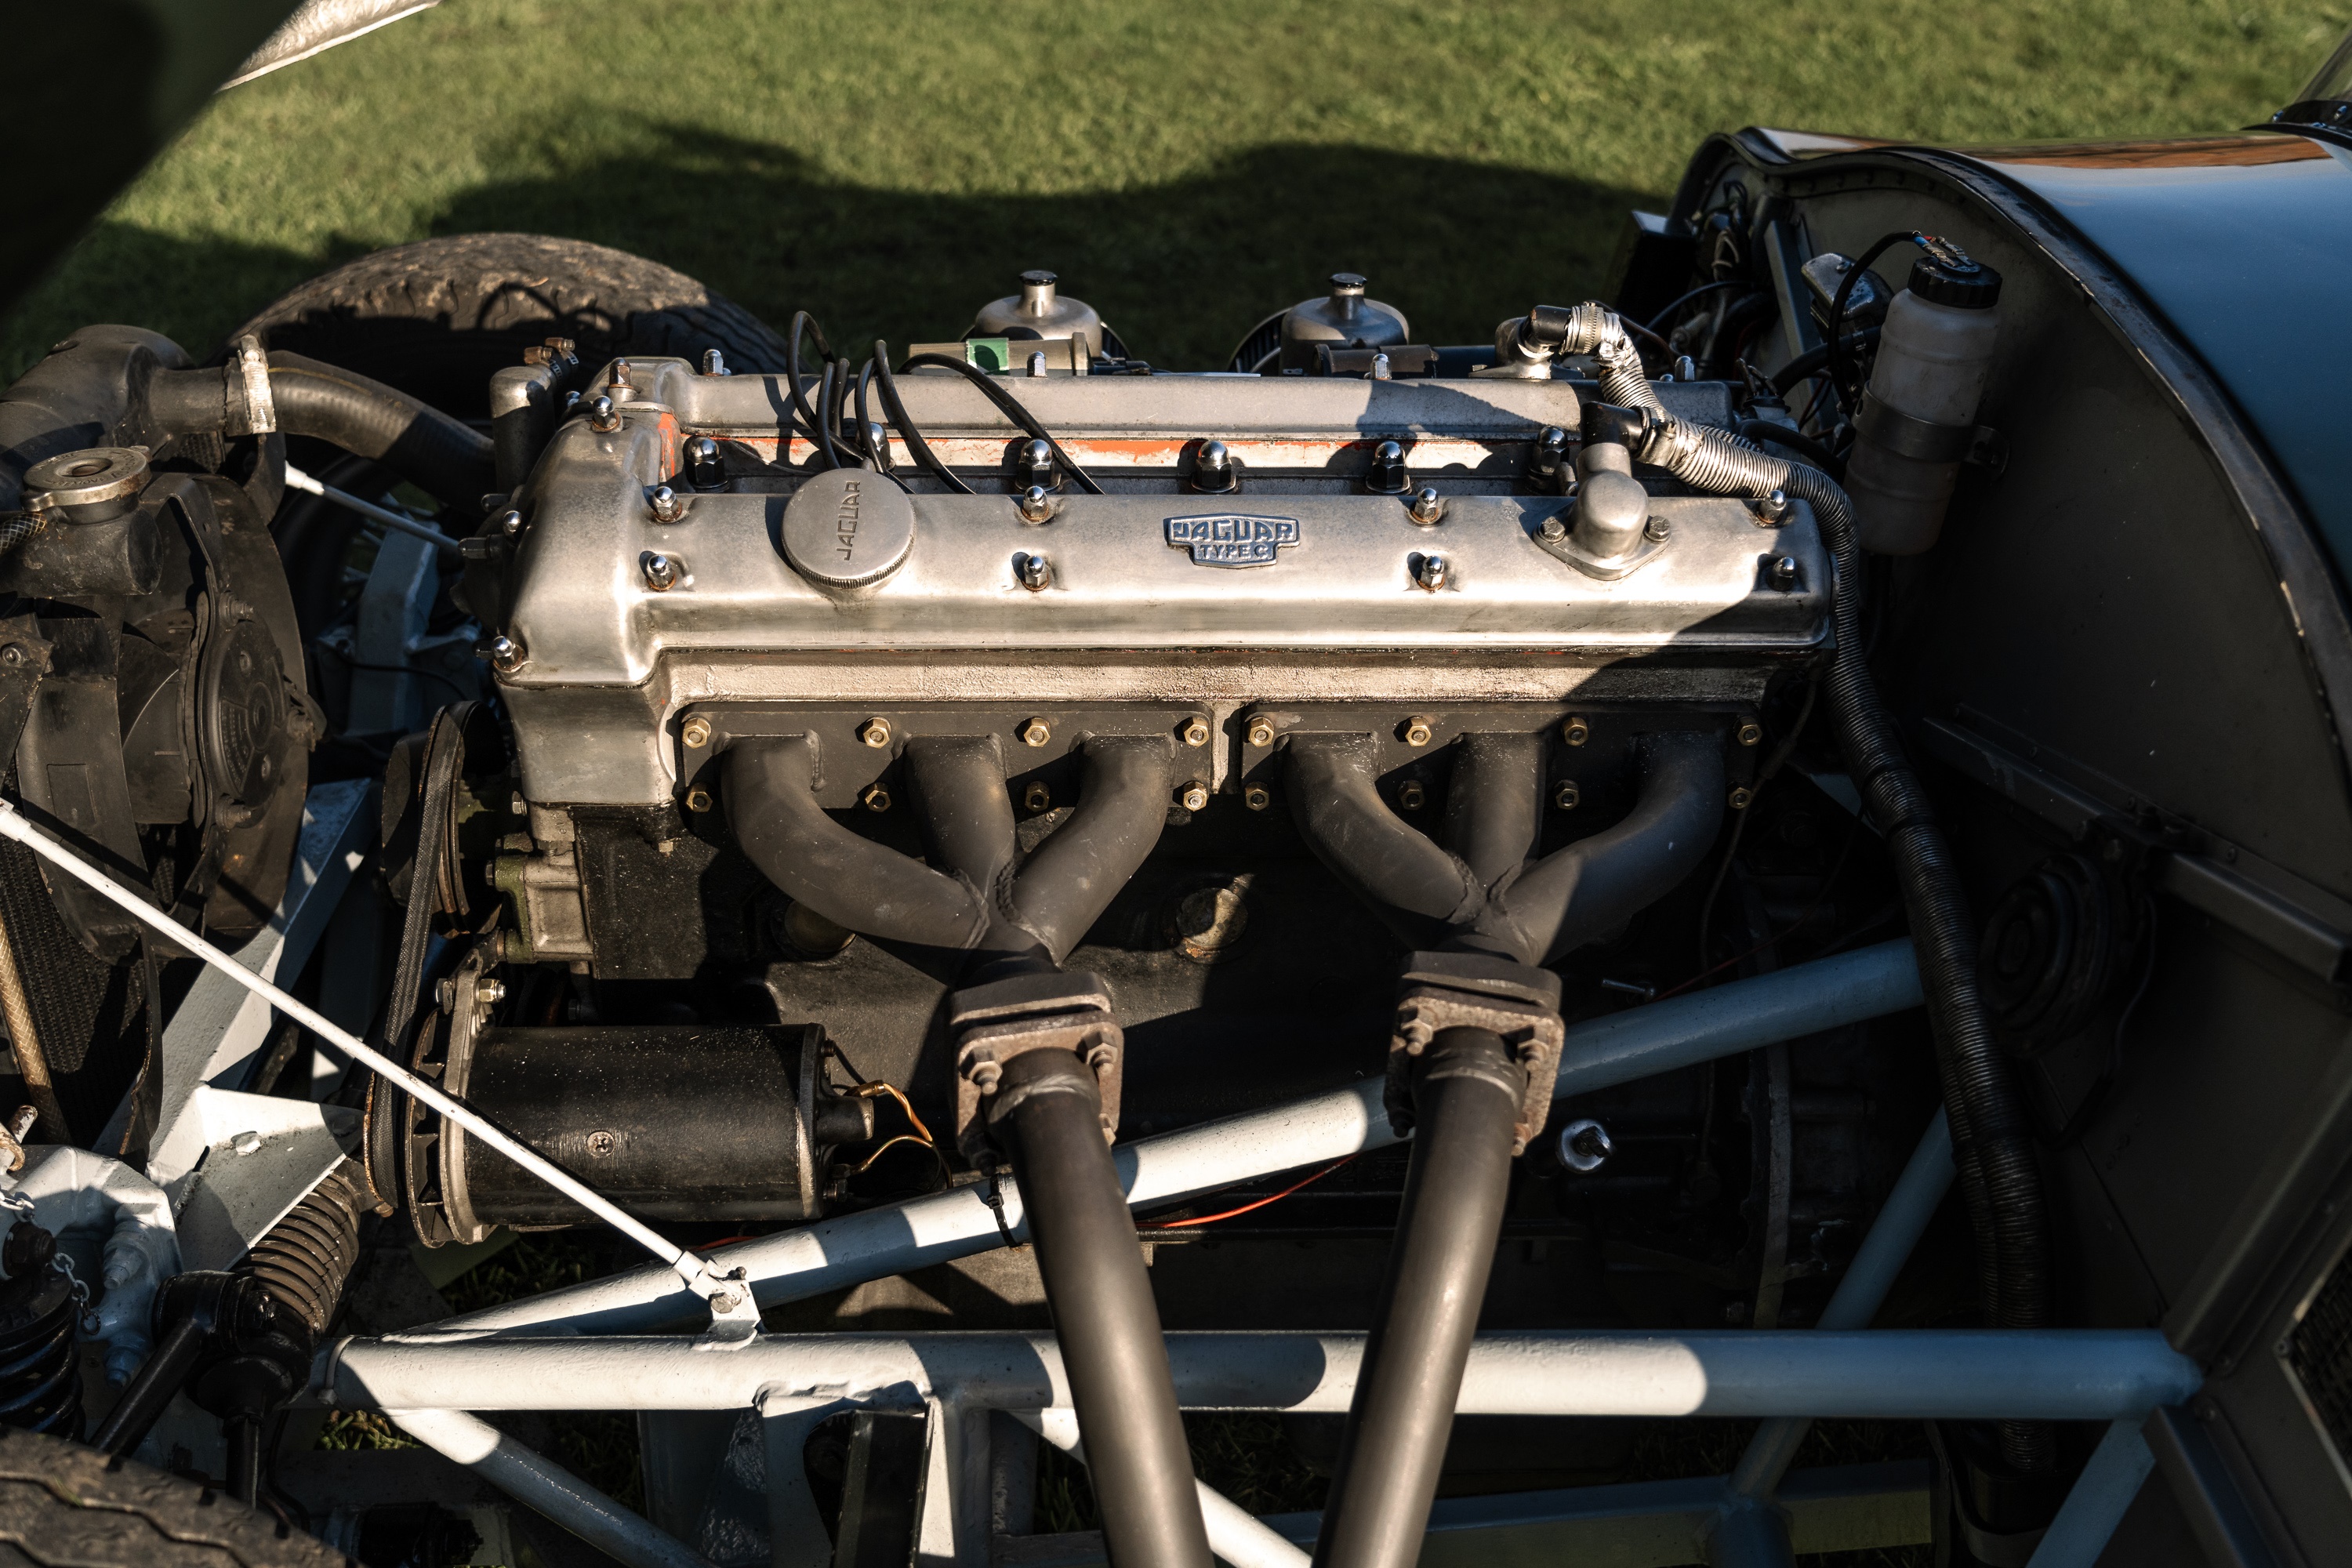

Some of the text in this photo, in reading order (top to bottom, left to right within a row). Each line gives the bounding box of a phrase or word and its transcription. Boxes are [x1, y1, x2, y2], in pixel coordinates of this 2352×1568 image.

[836, 481, 861, 561] JAGUAR
[1172, 519, 1295, 543] JAGUAR
[1200, 544, 1269, 560] TYPE C
